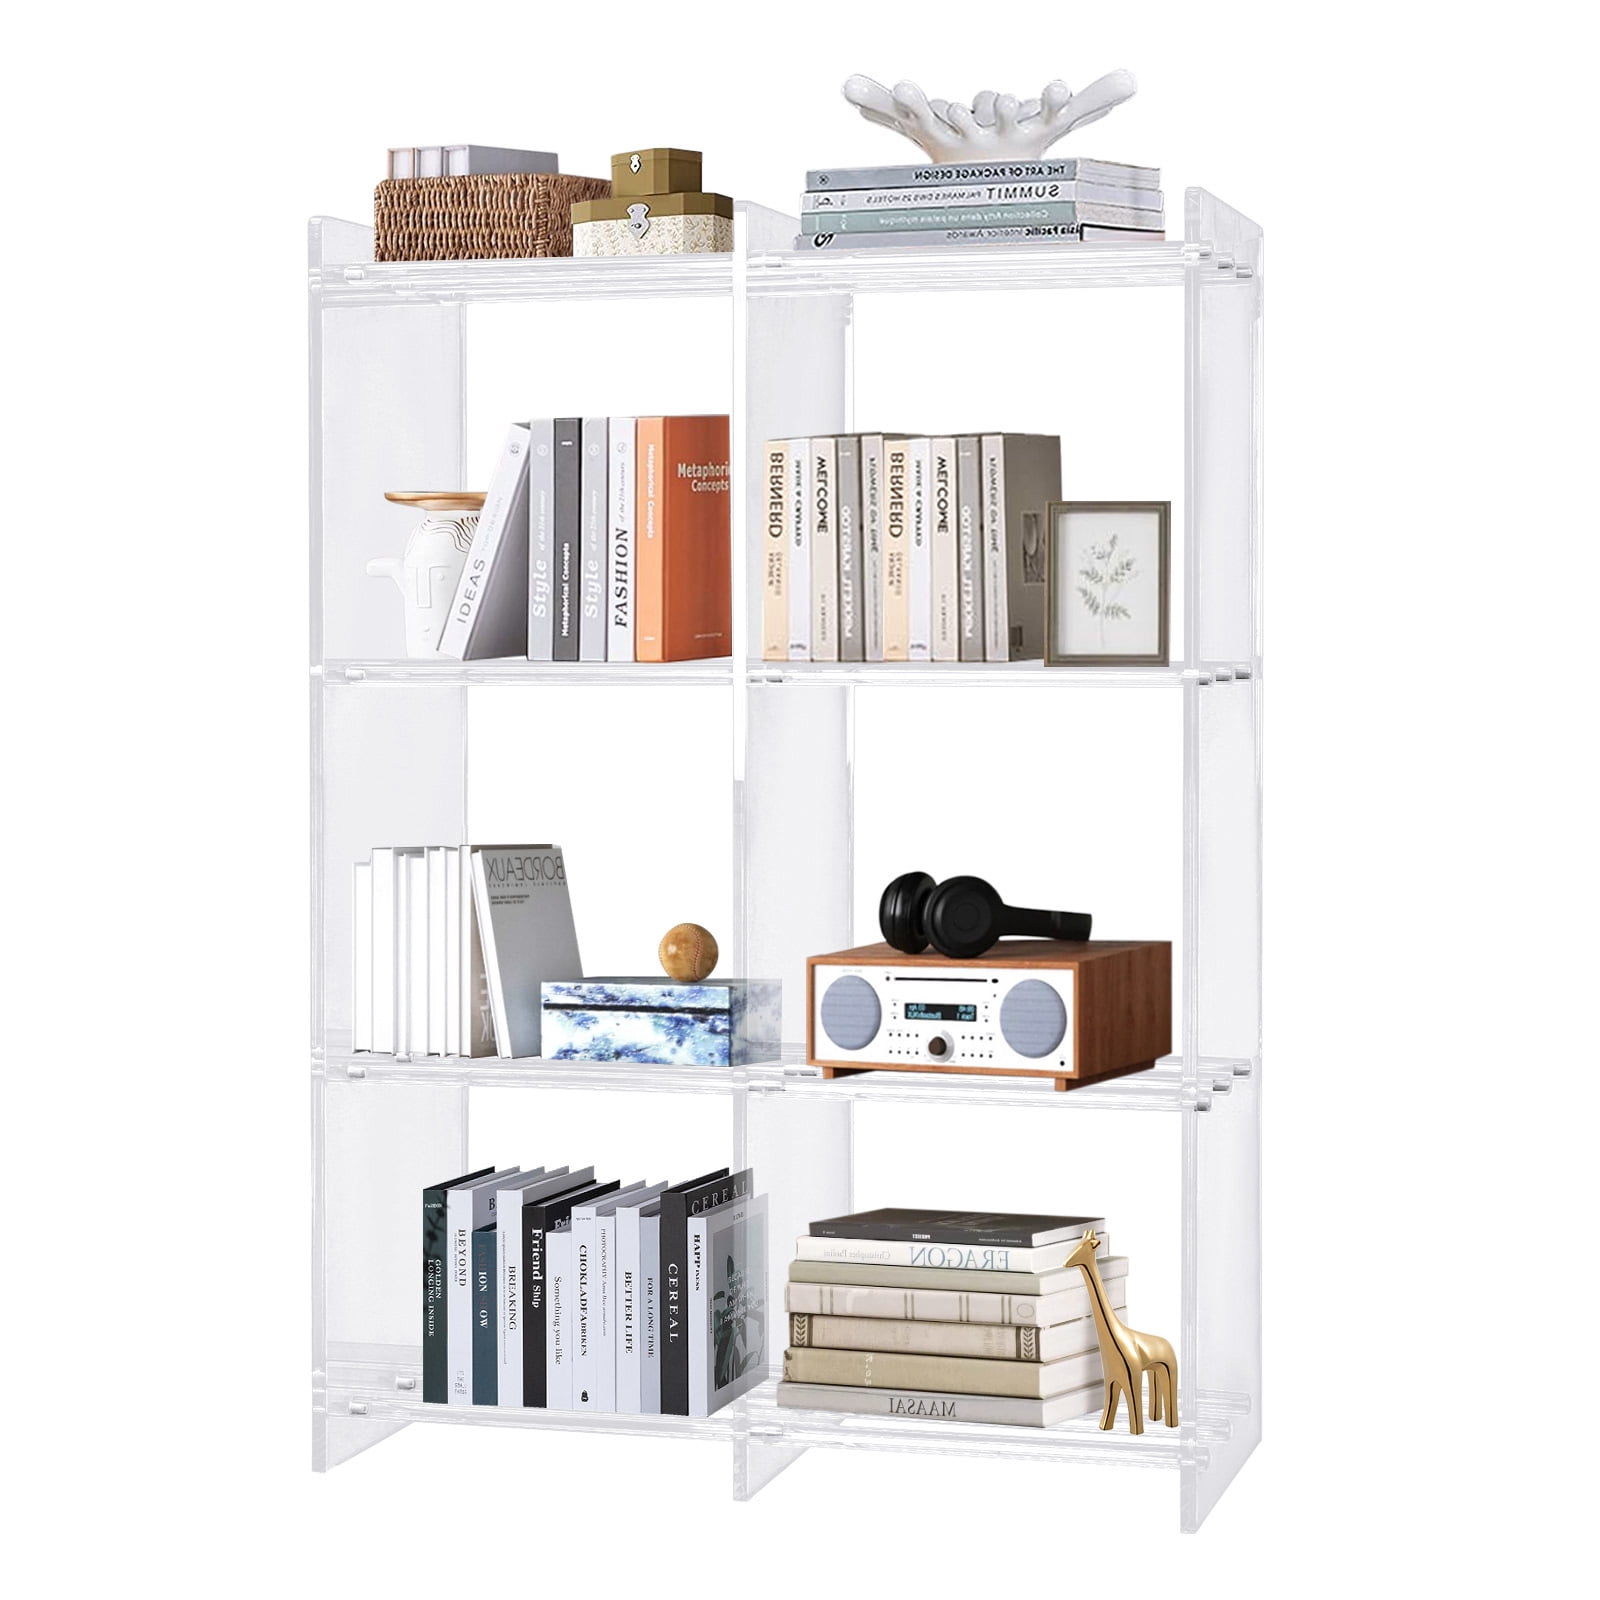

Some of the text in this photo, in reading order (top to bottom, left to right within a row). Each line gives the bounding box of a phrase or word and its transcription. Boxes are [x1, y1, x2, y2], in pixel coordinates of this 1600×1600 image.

[647, 444, 656, 539] Metaphorical Concepts
[677, 461, 731, 480] Metaphori
[691, 480, 730, 494] Concepts
[457, 558, 486, 624] IDEAS
[533, 559, 551, 618] Style
[560, 542, 571, 638] Metaphorical Concepts
[584, 559, 602, 618] Style
[614, 527, 629, 628] FASHION
[691, 1180, 748, 1215] CEREAL
[435, 1258, 443, 1300] GOLDEN
[457, 1228, 467, 1288] BEYOND
[531, 1227, 544, 1310] Friend Ship
[646, 1276, 654, 1297] FOR
[427, 1258, 436, 1338] LONGING INSIDE
[508, 1265, 518, 1332] BREAKING
[552, 1275, 564, 1366] Something you like
[578, 1244, 588, 1358] CHOKLADFABRIKEN
[624, 1270, 634, 1355] BETTER LIFE
[646, 1305, 654, 1333] LONG
[667, 1262, 680, 1344] CEREAL
[646, 1334, 654, 1359] TIME
